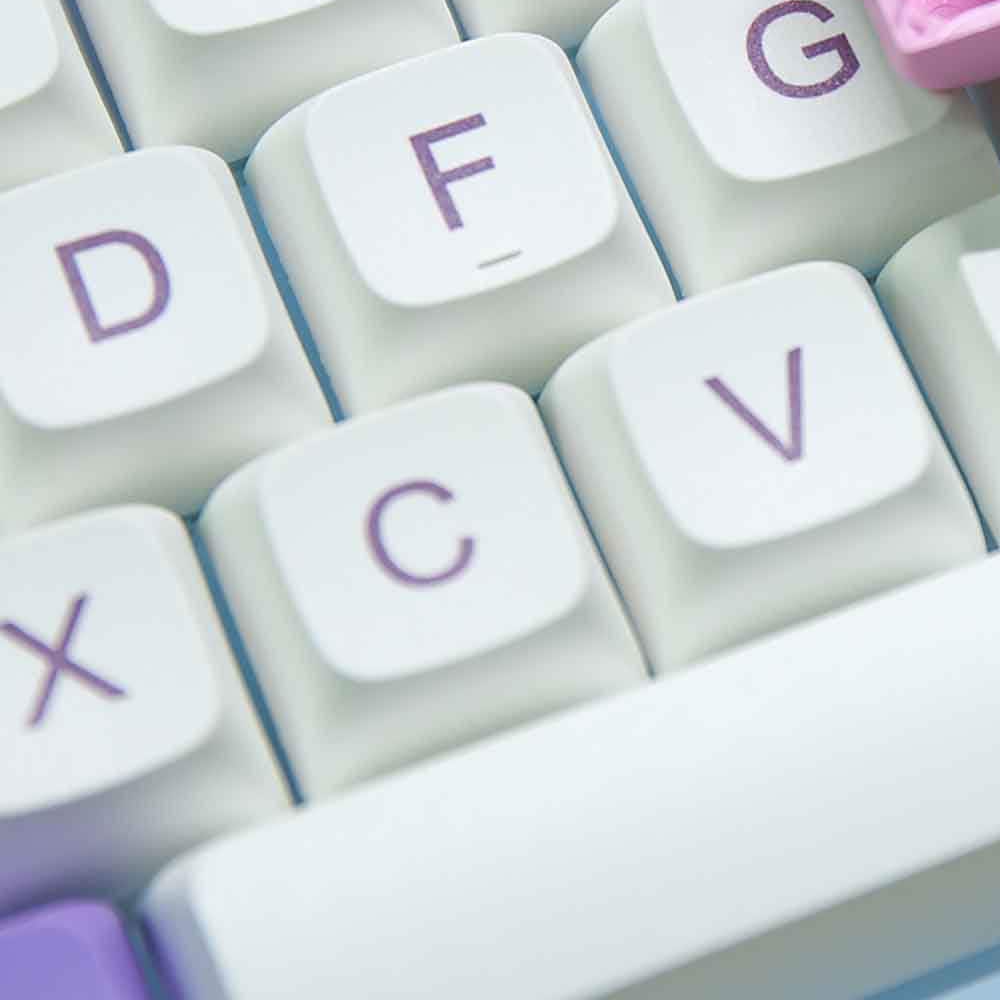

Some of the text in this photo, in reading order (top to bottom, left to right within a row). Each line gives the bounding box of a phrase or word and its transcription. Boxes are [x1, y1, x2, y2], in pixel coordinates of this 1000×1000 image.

[746, 0, 861, 98] G
[409, 113, 495, 230] F
[55, 228, 171, 343] D
[705, 346, 804, 462] V
[364, 479, 475, 587] C
[0, 591, 128, 728] X
